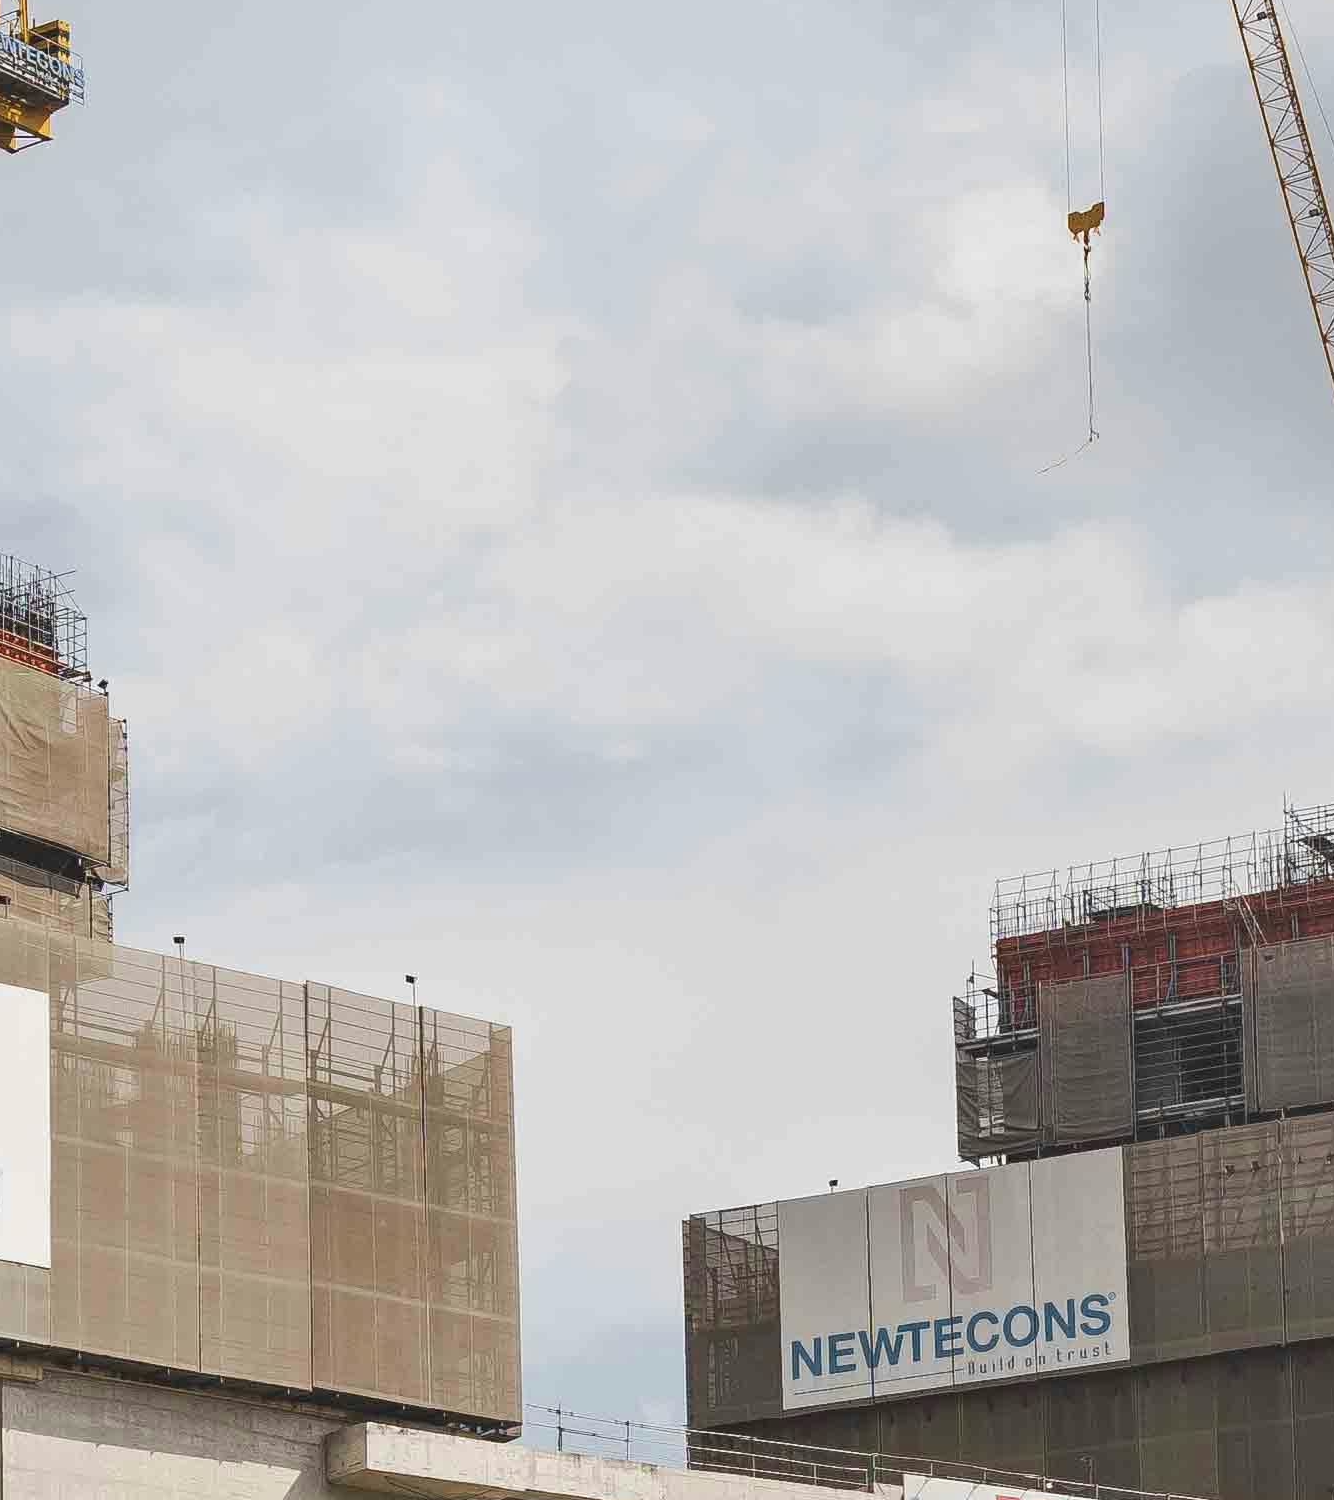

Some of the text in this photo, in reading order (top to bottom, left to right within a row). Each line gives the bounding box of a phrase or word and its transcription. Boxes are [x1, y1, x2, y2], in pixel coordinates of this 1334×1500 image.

[792, 1293, 1112, 1380] NEWTECONS
[968, 1341, 1111, 1376] Build on trust
